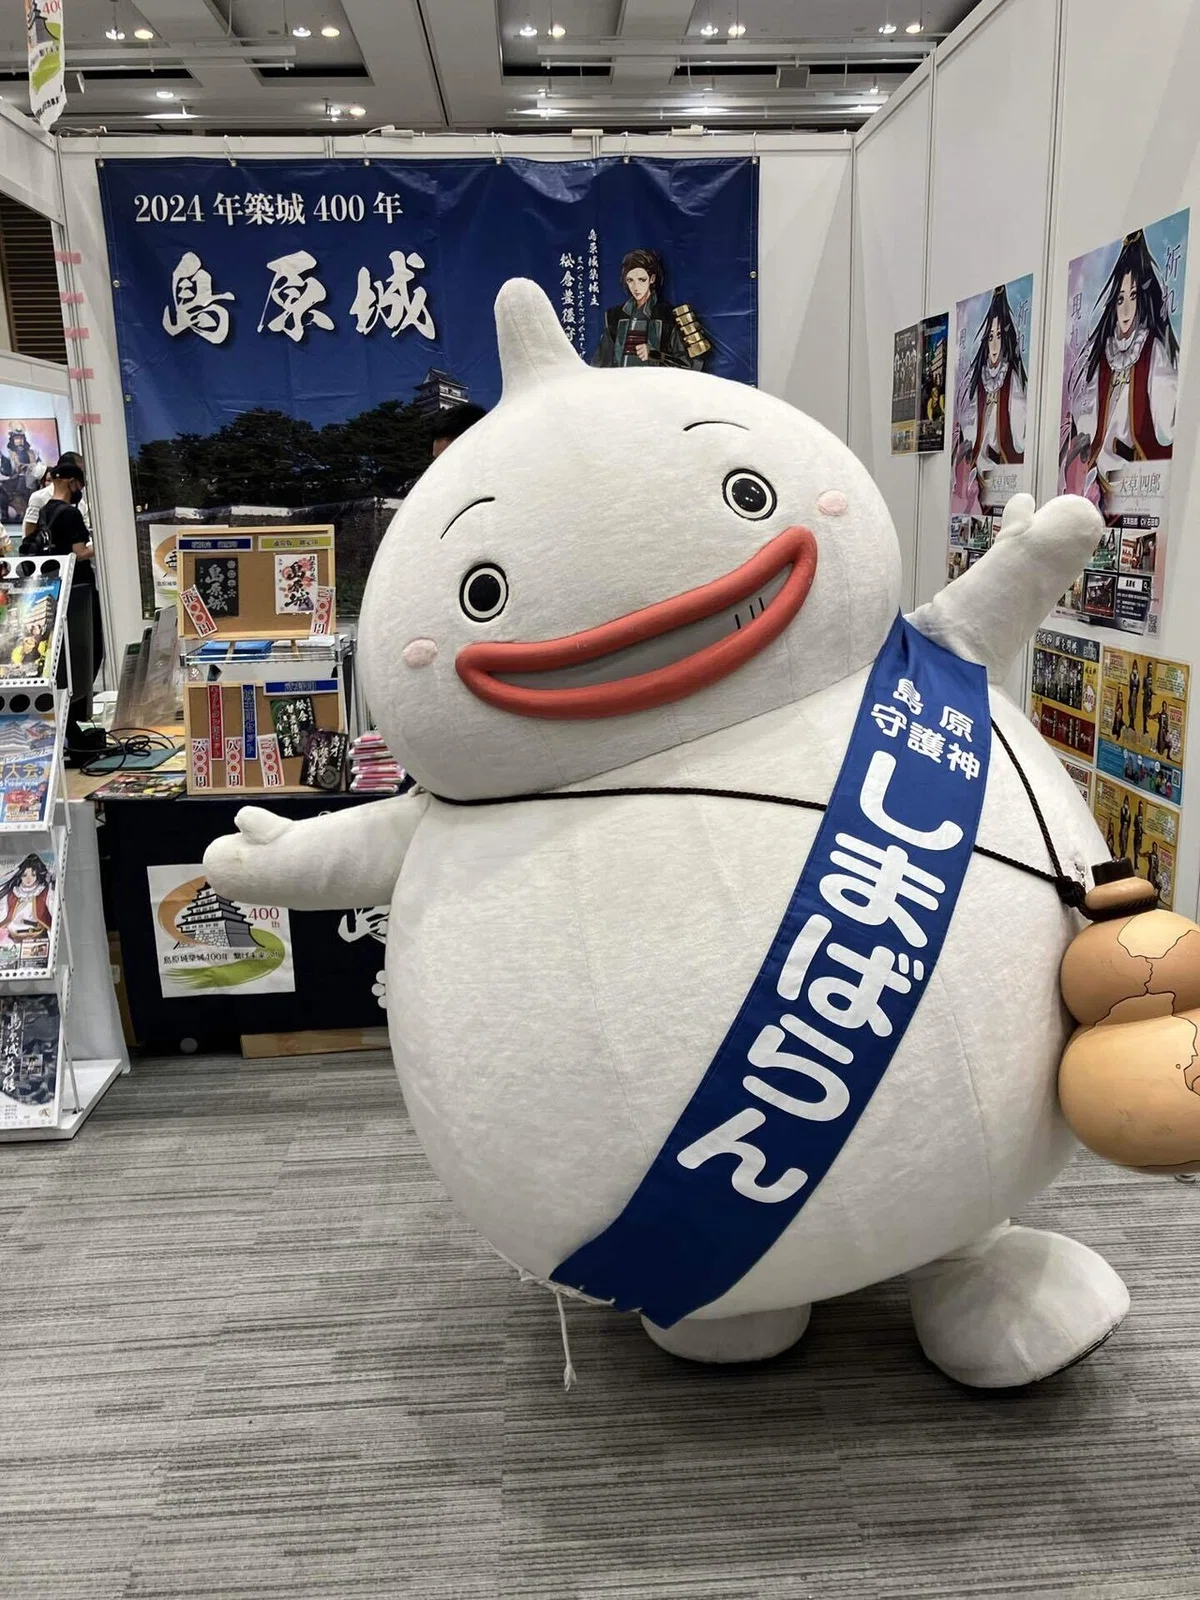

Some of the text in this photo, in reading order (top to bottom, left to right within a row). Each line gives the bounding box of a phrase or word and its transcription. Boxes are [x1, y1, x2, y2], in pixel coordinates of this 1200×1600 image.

[162, 250, 436, 345] 島原城
[870, 702, 982, 782] 守護神
[893, 677, 974, 744] 島原
[249, 907, 280, 921] 400
[676, 750, 964, 1204] しまばらん
